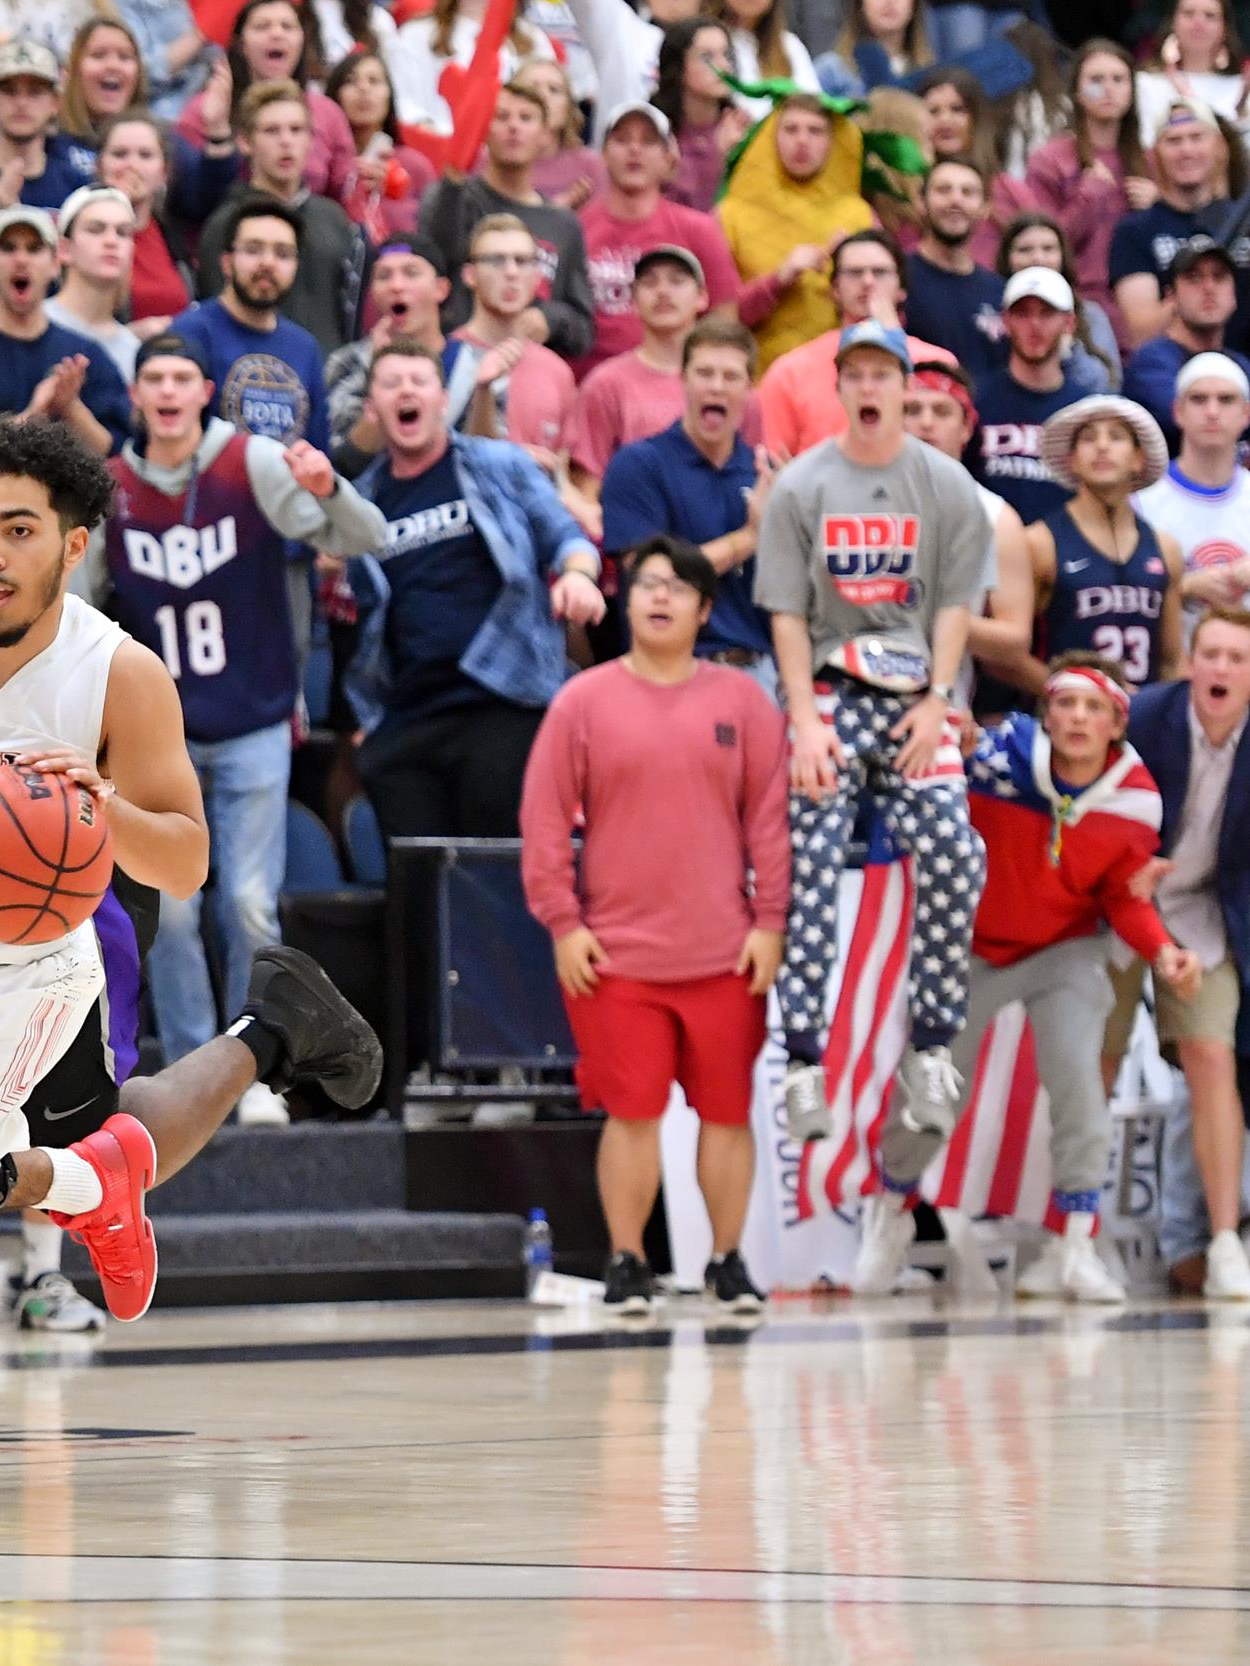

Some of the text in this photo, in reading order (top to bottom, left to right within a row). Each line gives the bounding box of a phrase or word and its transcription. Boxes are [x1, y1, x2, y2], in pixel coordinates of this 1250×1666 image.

[123, 515, 238, 590] DBU
[1075, 585, 1163, 619] DBU
[154, 600, 227, 680] 18
